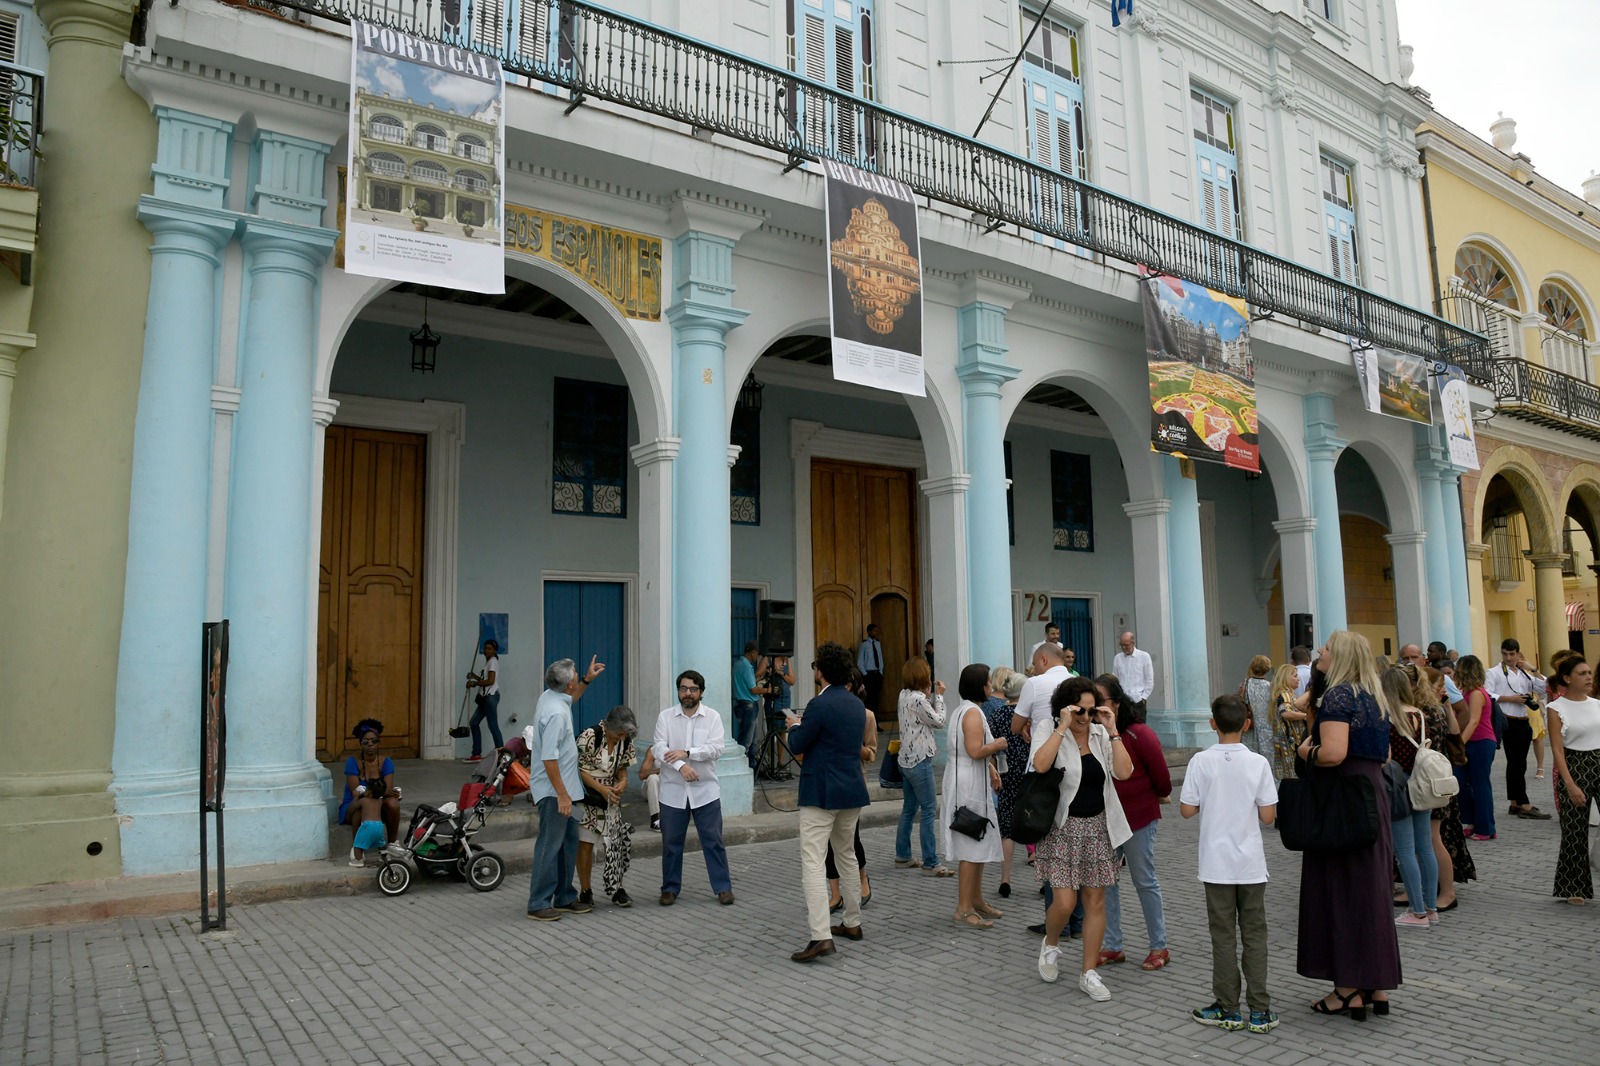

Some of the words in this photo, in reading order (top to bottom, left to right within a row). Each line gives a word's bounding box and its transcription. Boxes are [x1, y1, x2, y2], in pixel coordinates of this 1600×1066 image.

[362, 23, 496, 81] PORTUGAL
[827, 160, 910, 203] BULGARIA
[551, 218, 662, 319] ESPAÑOLES
[1024, 593, 1050, 622] 72
